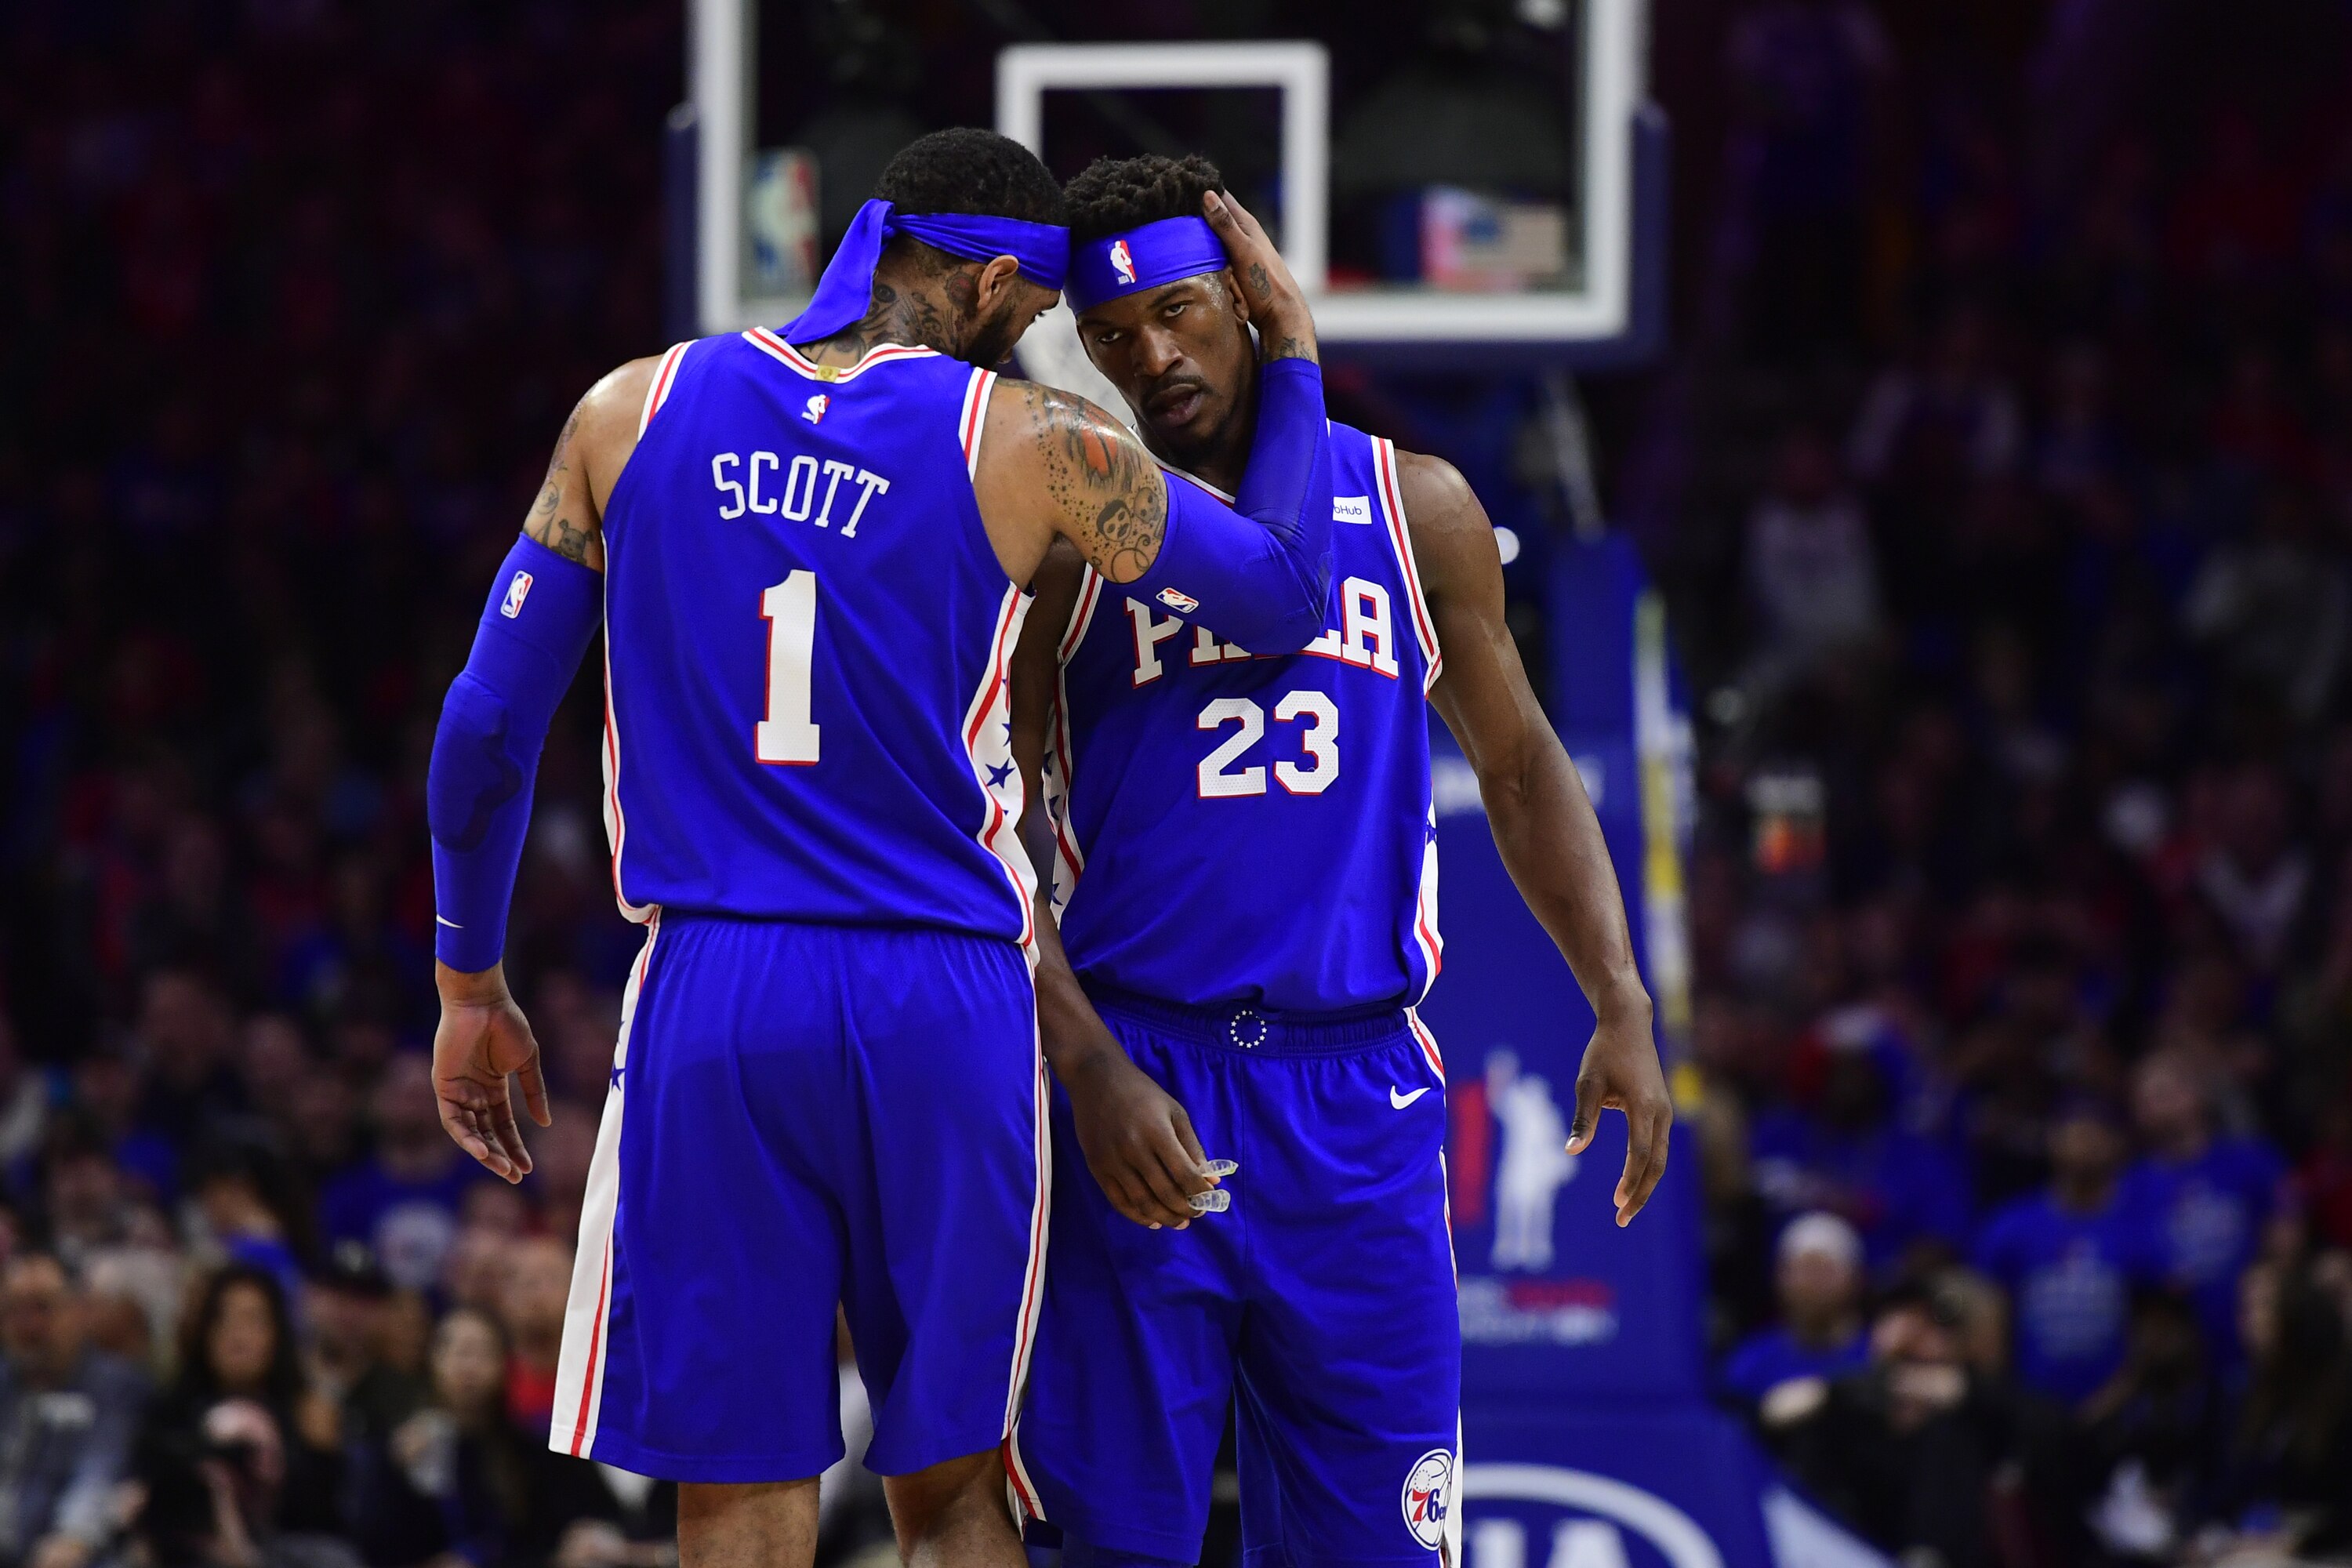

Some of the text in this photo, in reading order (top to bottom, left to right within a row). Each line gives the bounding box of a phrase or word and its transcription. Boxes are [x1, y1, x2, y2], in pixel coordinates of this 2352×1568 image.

[711, 450, 890, 539] SCOTT
[754, 568, 820, 766] 1
[1196, 690, 1339, 798] 23
